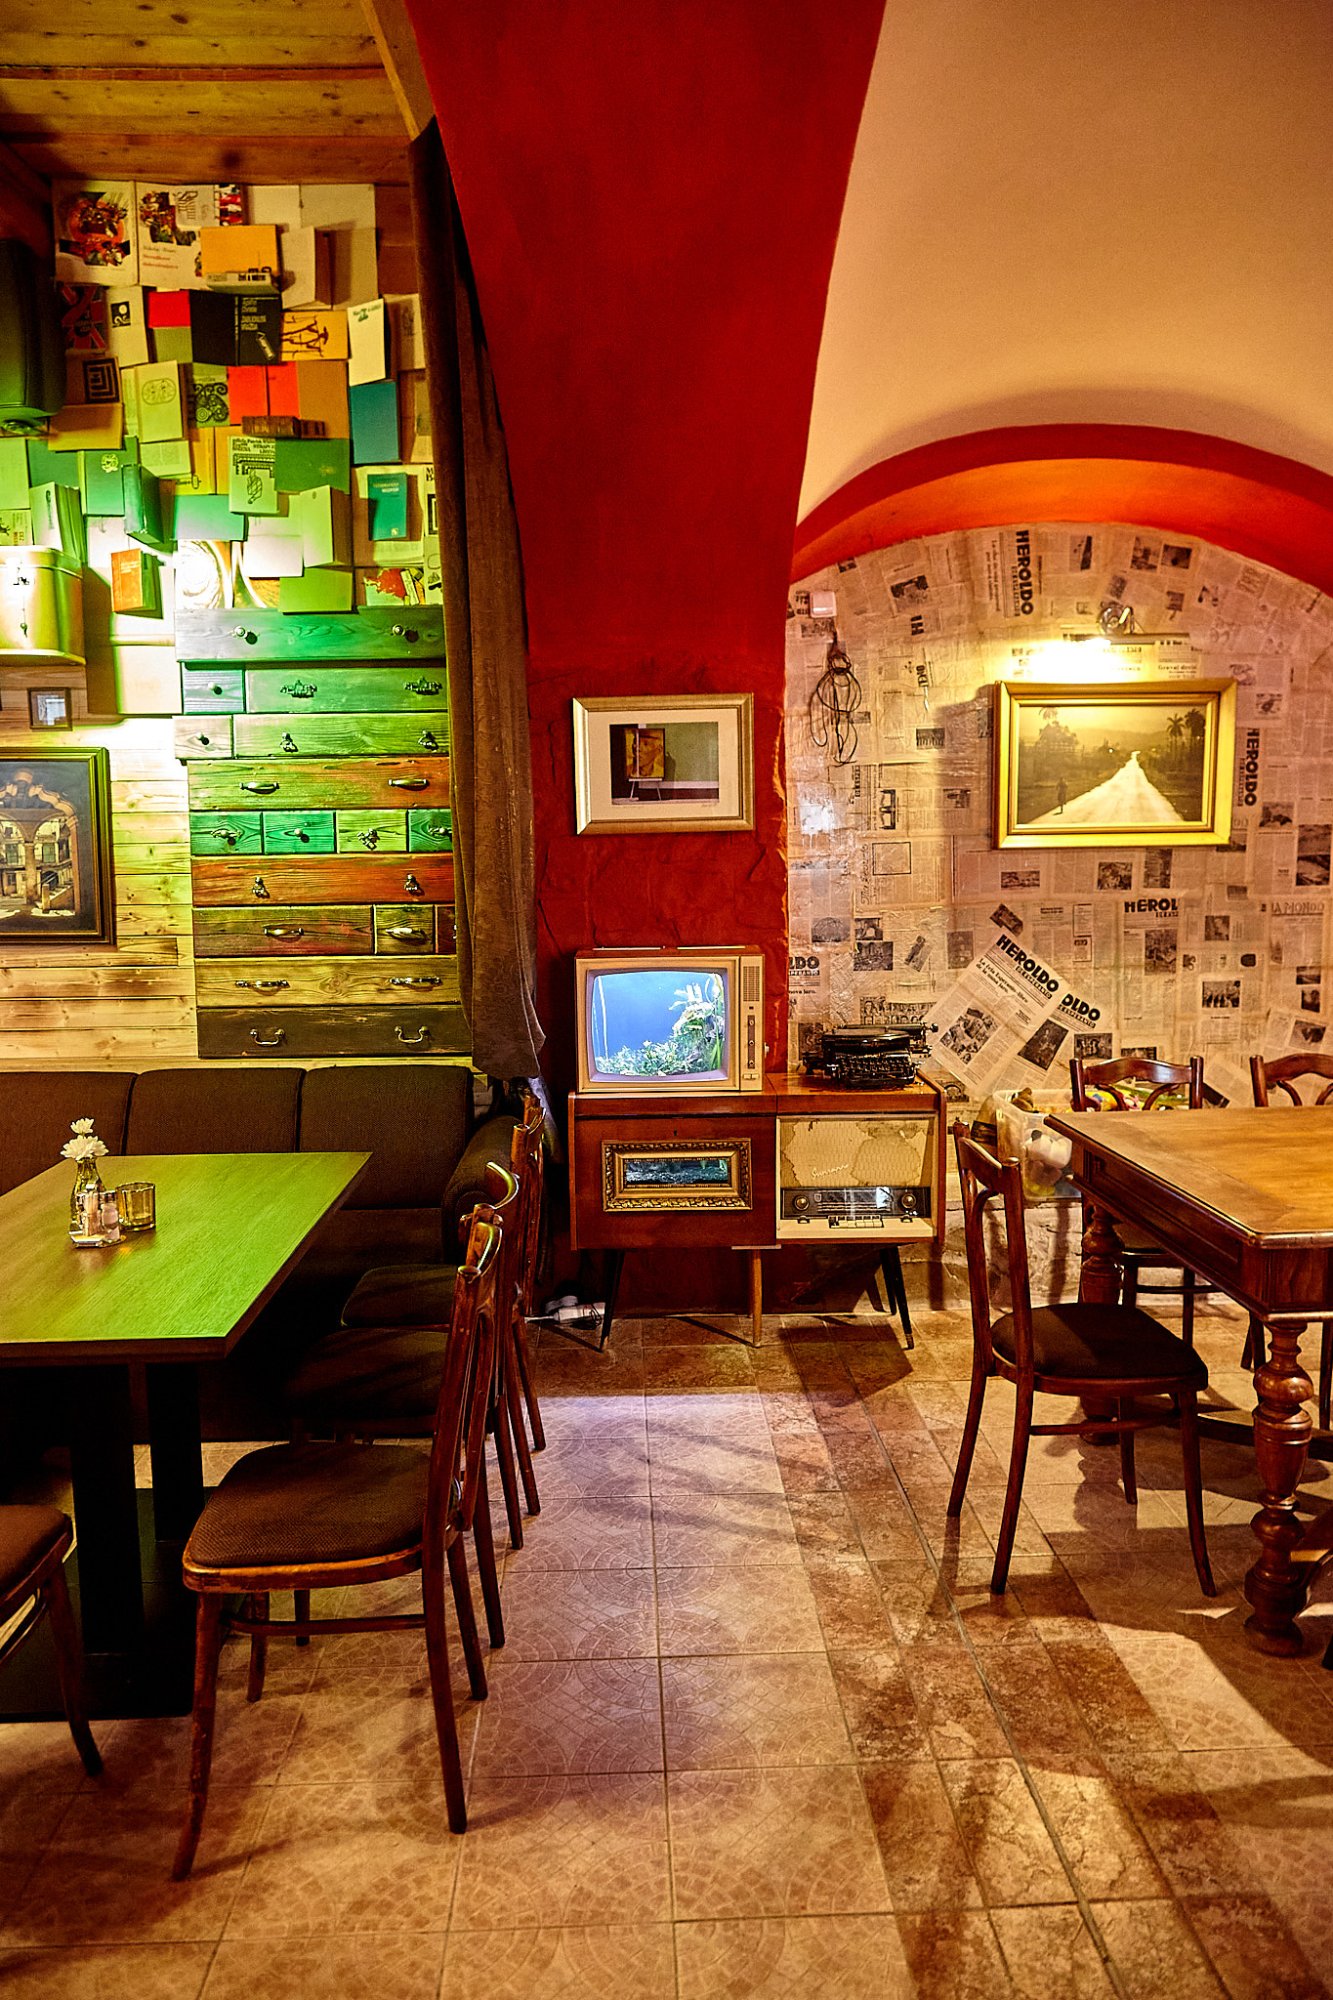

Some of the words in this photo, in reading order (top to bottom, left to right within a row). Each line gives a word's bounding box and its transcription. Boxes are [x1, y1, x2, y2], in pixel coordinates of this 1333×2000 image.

[1016, 530, 1034, 615] HEROLDO
[1244, 728, 1260, 806] HEROLDO
[1124, 898, 1178, 913] HEROL
[788, 956, 820, 969] LDO
[996, 934, 1059, 993] HEROLDO
[1022, 971, 1053, 1000] ESPERANTO
[1061, 993, 1101, 1022] OLDO
